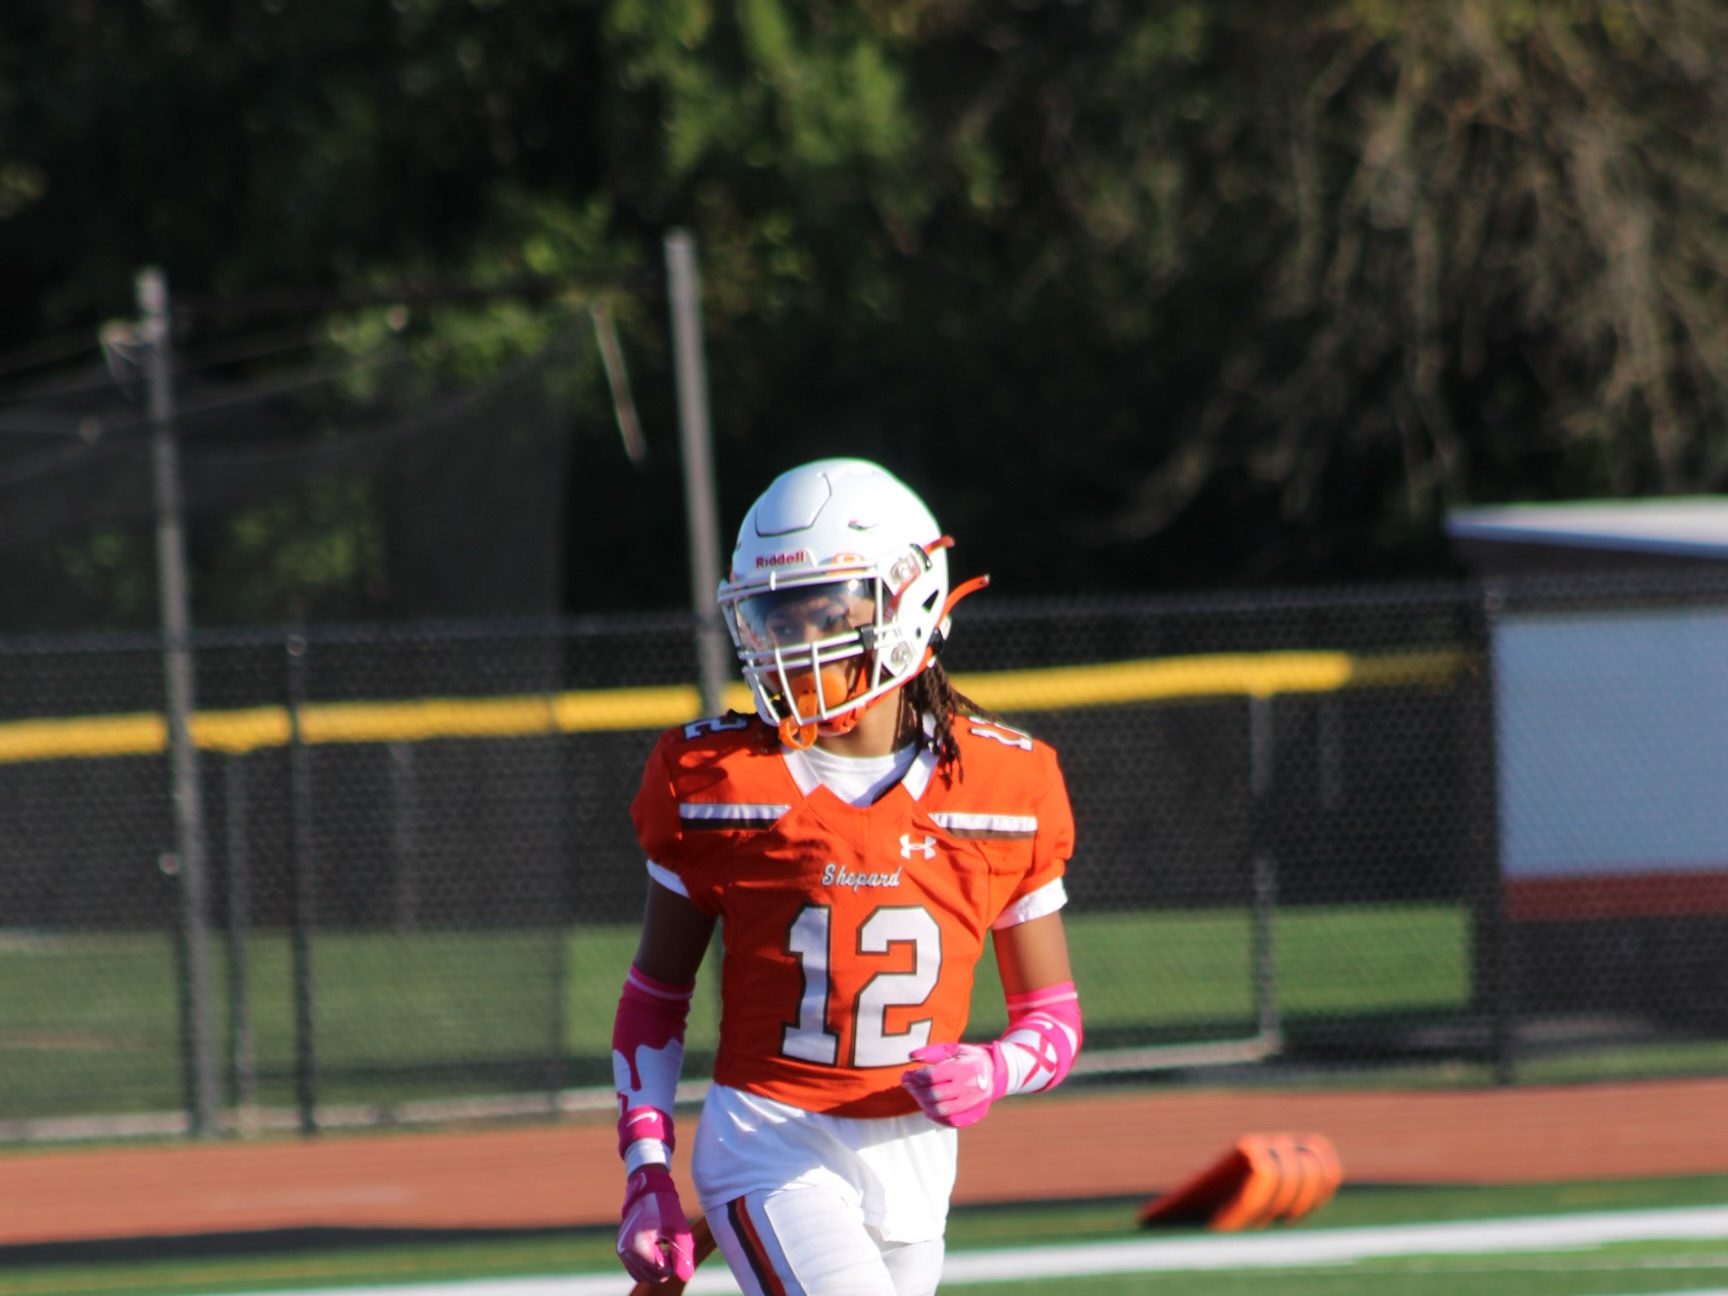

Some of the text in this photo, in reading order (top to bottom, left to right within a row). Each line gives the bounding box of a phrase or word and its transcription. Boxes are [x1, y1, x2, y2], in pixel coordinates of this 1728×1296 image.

[755, 550, 805, 569] Riddell
[821, 863, 903, 893] Shepard
[778, 903, 943, 1069] 12
